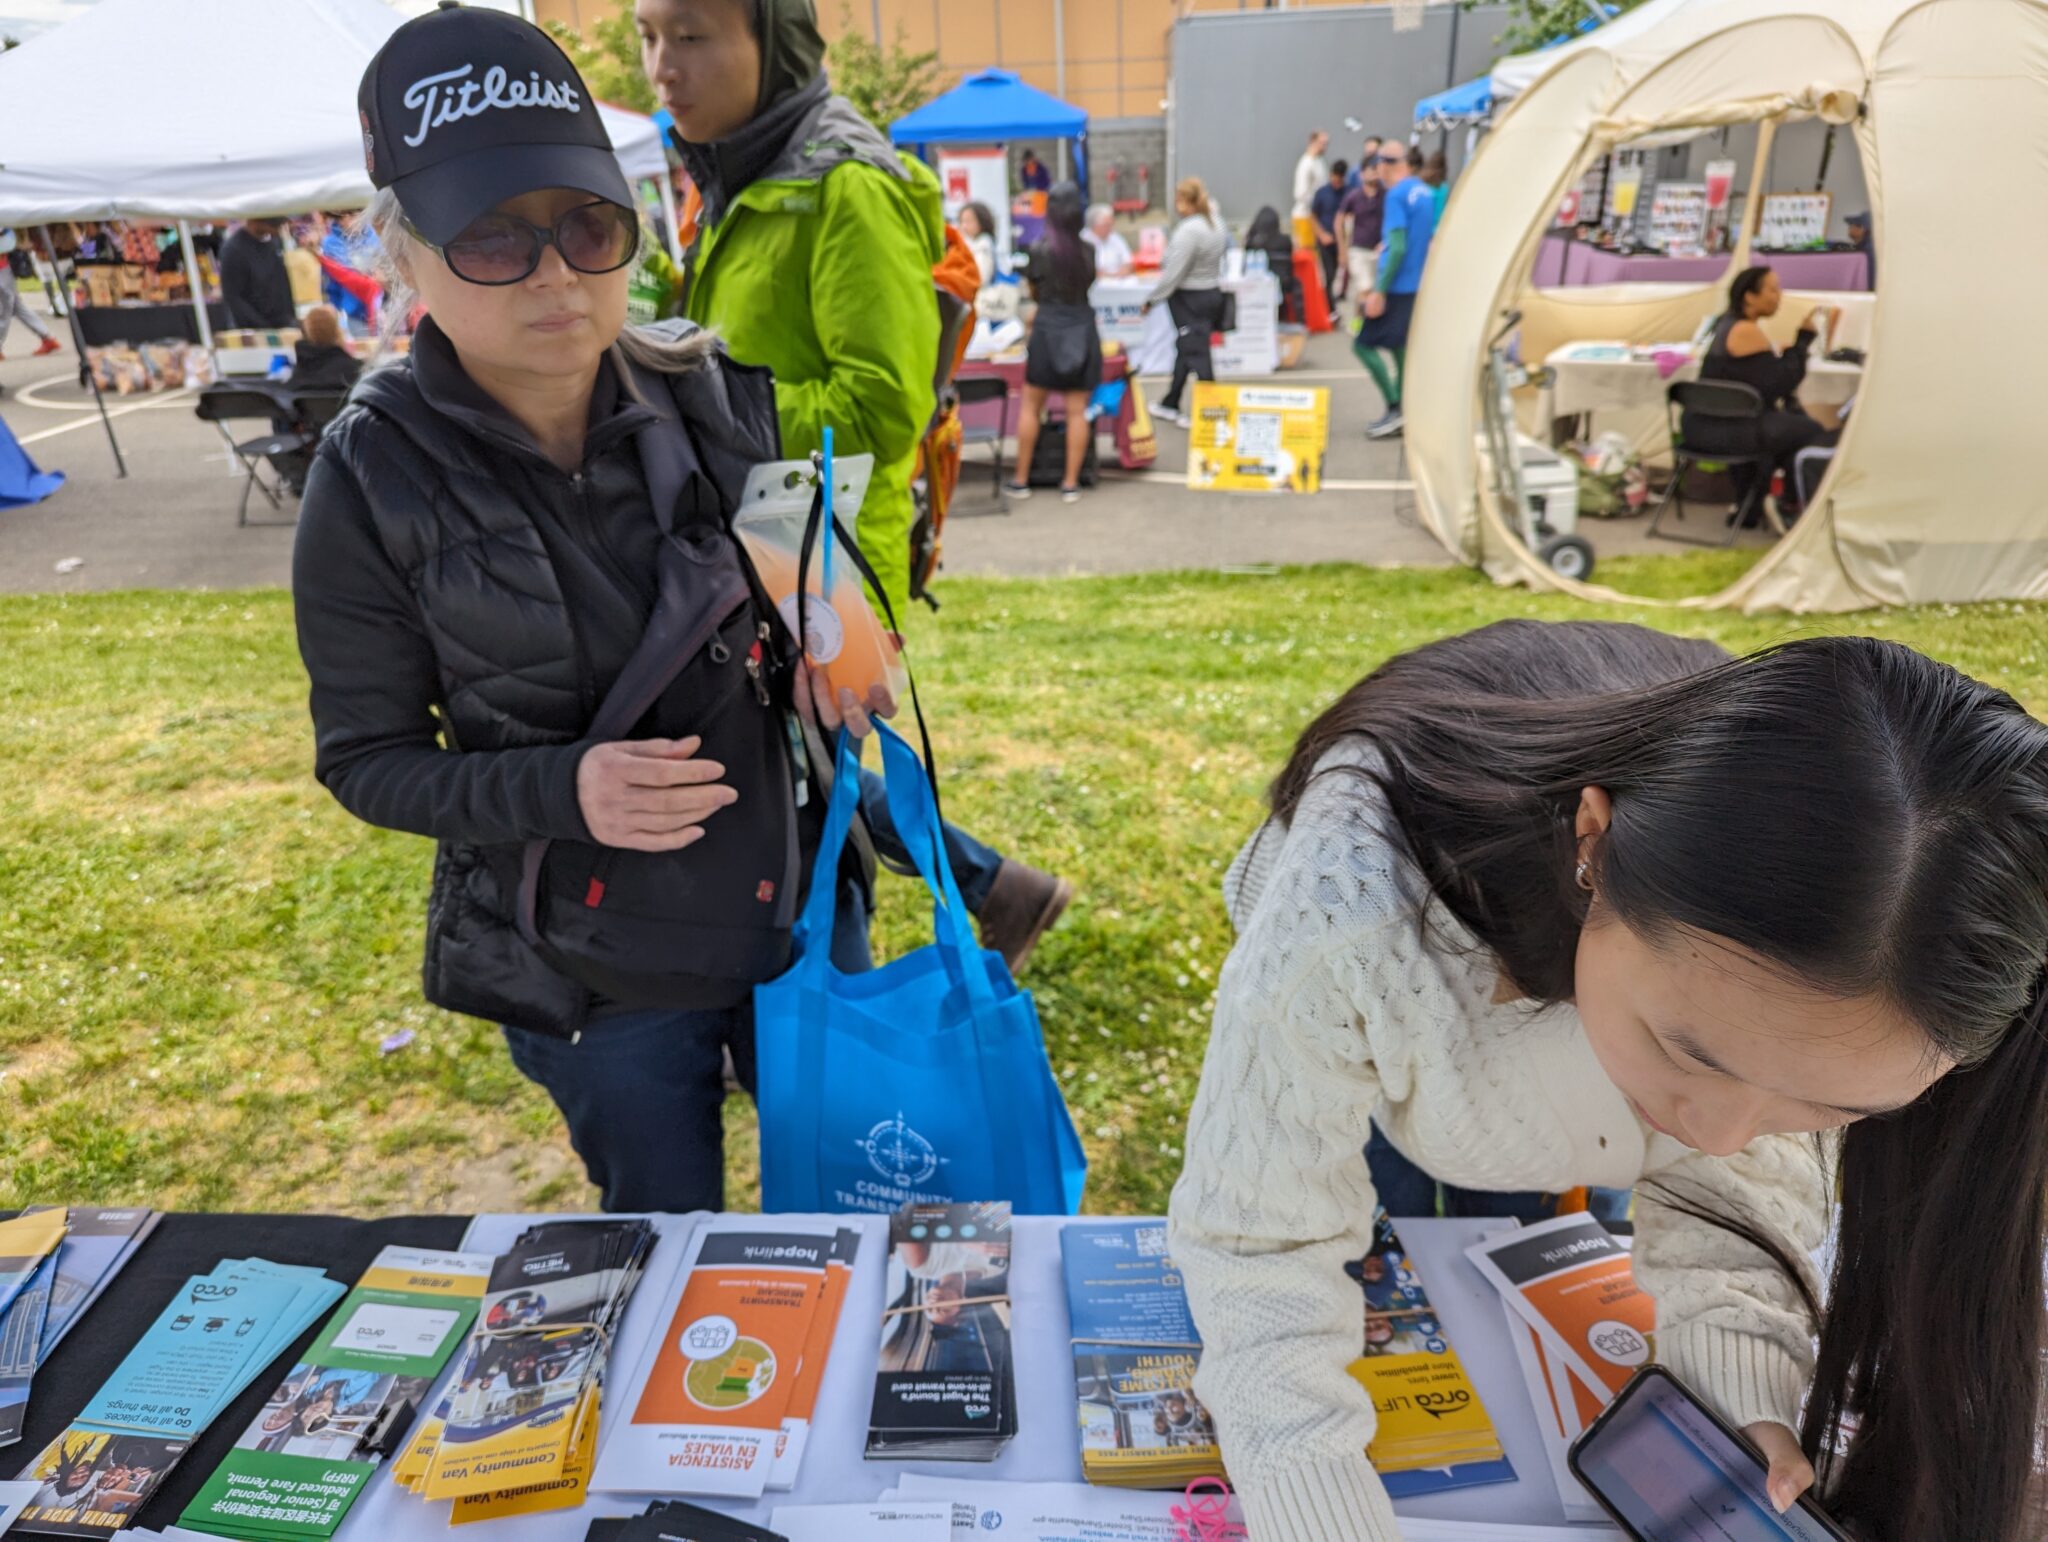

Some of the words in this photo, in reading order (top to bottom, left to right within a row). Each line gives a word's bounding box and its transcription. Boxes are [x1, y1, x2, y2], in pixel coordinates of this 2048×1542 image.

[404, 63, 580, 147] Titleist
[856, 1180, 953, 1204] COMMUNITY
[743, 1245, 818, 1262] hopelink
[1540, 1237, 1610, 1263] hopelink
[191, 1284, 238, 1301] orca
[356, 1327, 386, 1339] orca
[1136, 1354, 1195, 1367] YOUTH!
[1430, 1372, 1460, 1382] Lower
[890, 1383, 913, 1392] card
[914, 1382, 945, 1392] transit
[900, 1392, 940, 1402] Sound's
[942, 1391, 970, 1402] Puget
[972, 1392, 990, 1402] The
[1414, 1390, 1470, 1412] orca
[106, 1400, 139, 1413] things.
[142, 1404, 158, 1414] the
[160, 1406, 173, 1415] all
[1371, 1396, 1410, 1412] LIFT
[174, 1406, 191, 1416] Do
[964, 1404, 990, 1418] orca
[104, 1412, 140, 1424] places.
[142, 1414, 158, 1424] the
[160, 1417, 174, 1426] all
[176, 1418, 192, 1428] Go
[684, 1442, 733, 1456] VIAJES
[737, 1445, 758, 1457] EN
[1097, 1450, 1118, 1458] PASS
[1120, 1449, 1156, 1457] TRANSIT
[472, 1452, 556, 1476] Community
[668, 1454, 754, 1471] ASISTENCIA
[322, 1470, 359, 1484] RRFP)
[442, 1467, 468, 1480] Van
[272, 1478, 299, 1492] Fare
[299, 1482, 350, 1498] Reduced
[496, 1478, 578, 1502] Community
[225, 1488, 282, 1504] Regional
[283, 1494, 327, 1509] (Senior
[464, 1492, 490, 1506] Van
[325, 1498, 341, 1511] 可
[78, 1510, 126, 1528] YOUTH
